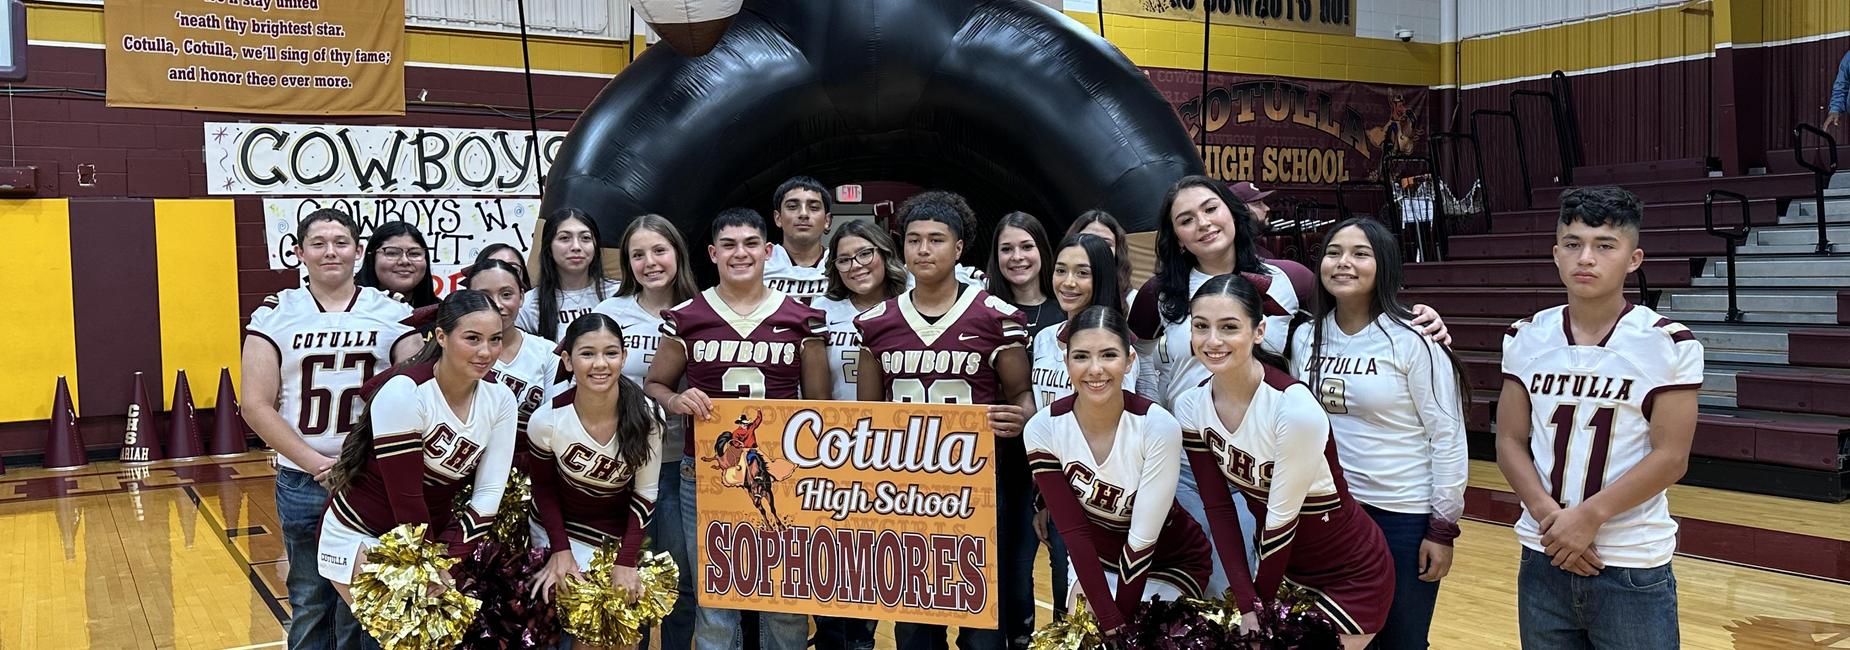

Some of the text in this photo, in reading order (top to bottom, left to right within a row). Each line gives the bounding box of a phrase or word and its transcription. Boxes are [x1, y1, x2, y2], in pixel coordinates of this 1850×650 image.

[175, 12, 345, 38] 'neath thy brightest star.
[123, 36, 391, 66] Cotulla, Cotulla, we'll sing of thy fame;
[168, 66, 352, 89] and honor thee ever more.
[1262, 147, 1349, 183] SCHOOL
[768, 279, 825, 294] COTULL
[293, 330, 380, 350] COTULLA
[693, 340, 796, 366] COWBOYS
[881, 350, 981, 376] COWBOYS
[1032, 368, 1073, 390] OTULLA
[297, 350, 378, 438] 62
[490, 368, 545, 415] HS
[1320, 377, 1349, 414] 8
[1530, 372, 1634, 401] COTULLA
[782, 408, 988, 475] Cotulla
[1546, 400, 1621, 508] 11
[796, 478, 874, 521] High
[873, 480, 975, 519] School
[1064, 460, 1137, 517] CH
[706, 521, 987, 614] SOPHOMORES
